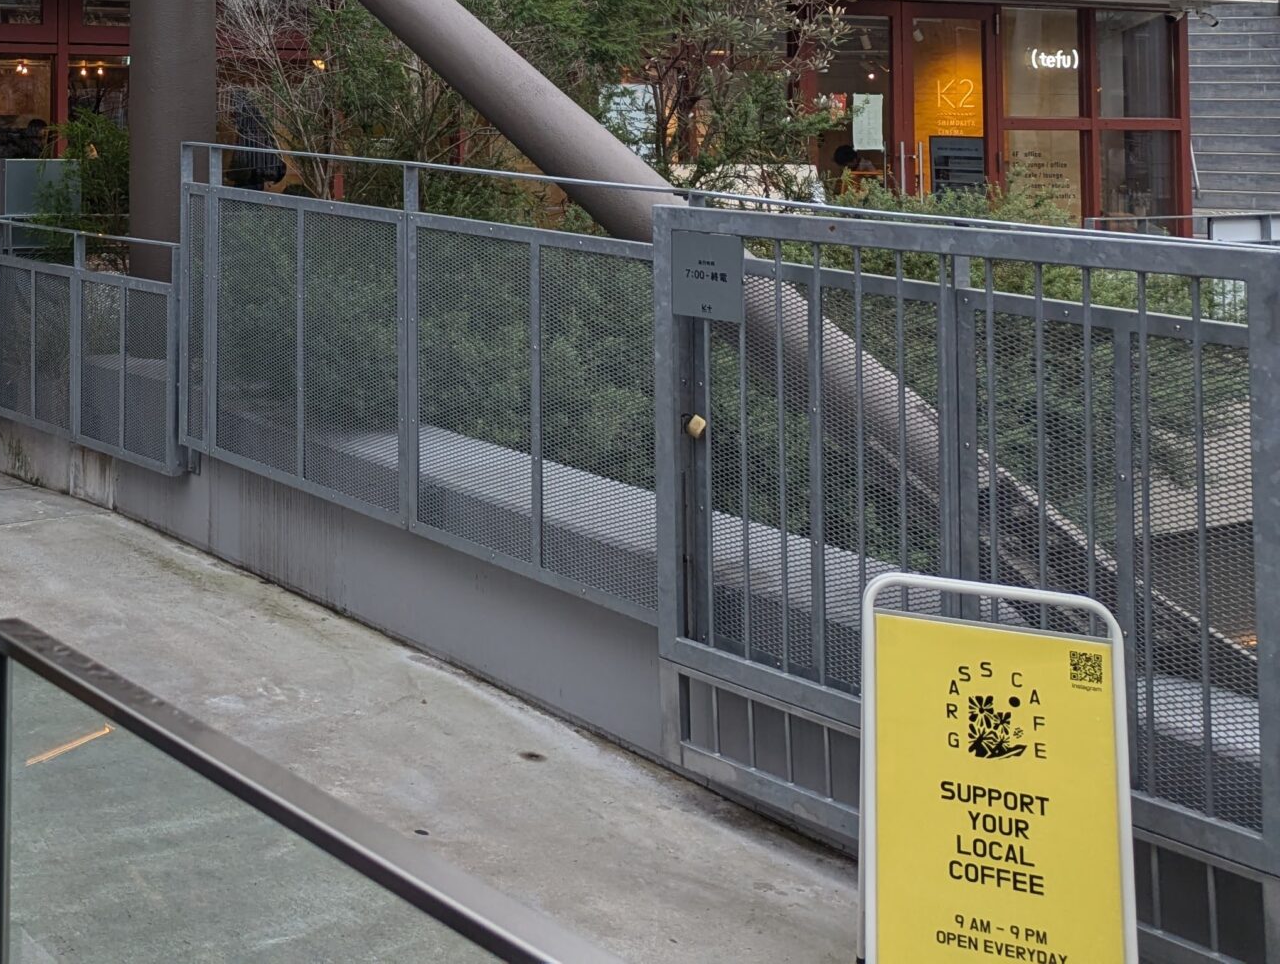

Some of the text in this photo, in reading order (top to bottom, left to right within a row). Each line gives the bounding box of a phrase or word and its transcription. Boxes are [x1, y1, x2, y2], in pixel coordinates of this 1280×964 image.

[937, 78, 975, 108] K2
[940, 780, 1050, 816] SUPPORT
[967, 810, 1030, 840] YOUR
[956, 834, 1036, 868] LOCAL
[948, 859, 1045, 896] COFFEE
[954, 914, 965, 928] 9
[969, 917, 991, 934] AM
[1009, 924, 1020, 940] 9
[1024, 928, 1048, 945] PM
[935, 930, 1068, 964] OPEN EVERYDAY
